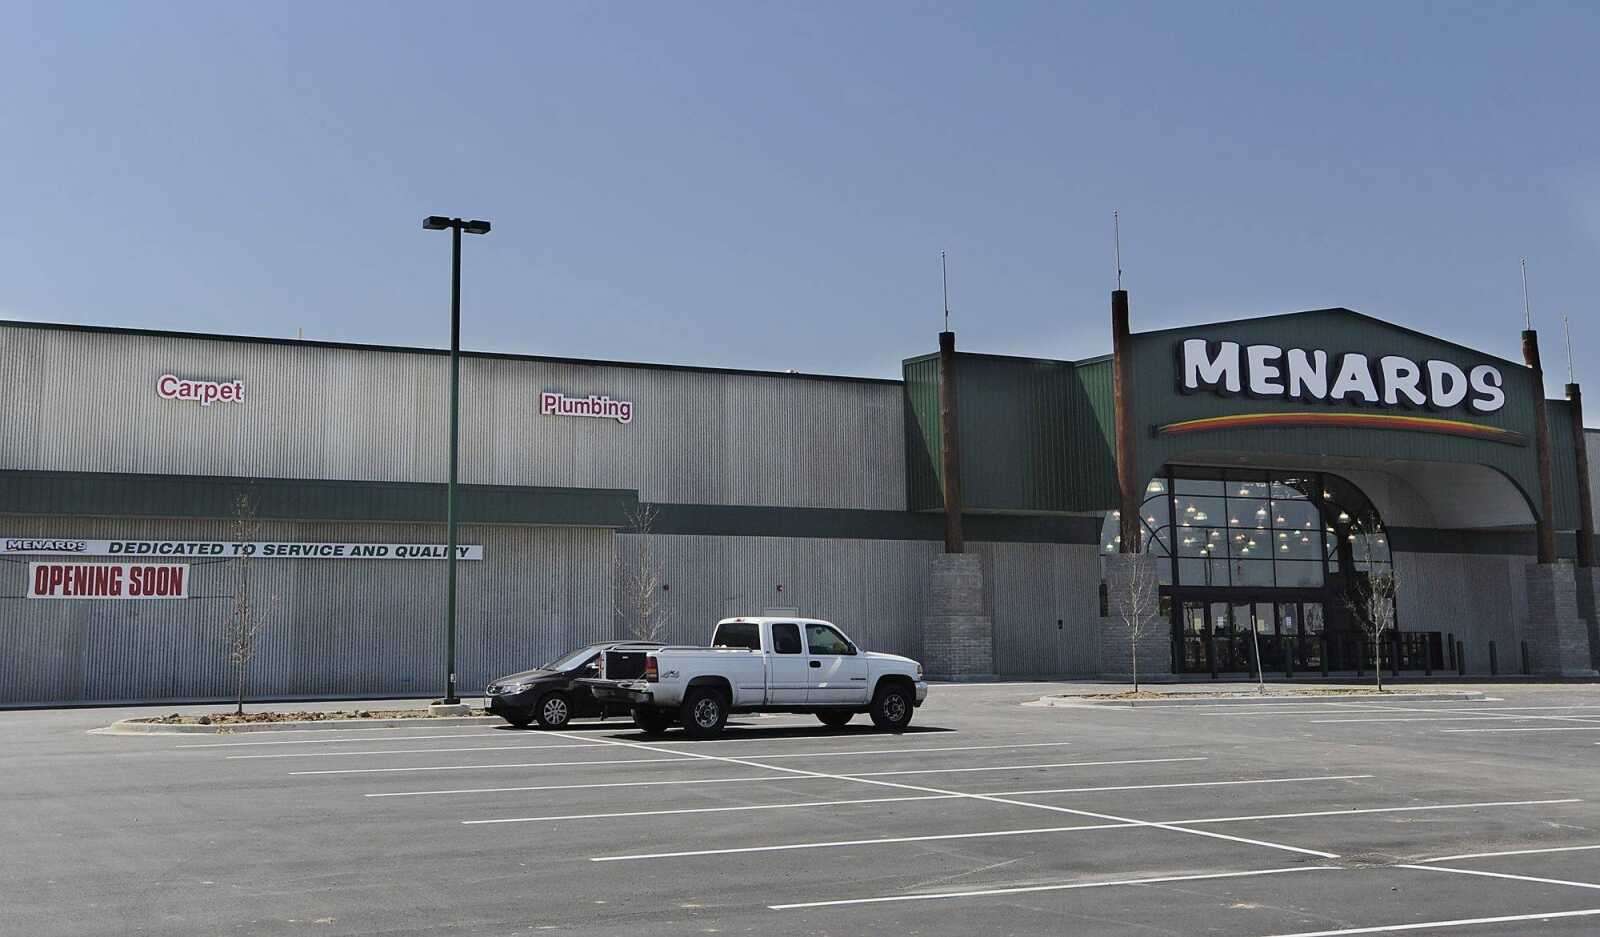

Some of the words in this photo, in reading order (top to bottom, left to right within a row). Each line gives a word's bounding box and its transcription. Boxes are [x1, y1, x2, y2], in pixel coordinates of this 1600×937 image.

[1182, 338, 1506, 412] MENARDS
[159, 376, 242, 403] Carpet
[543, 394, 631, 421] Plumbing
[6, 539, 88, 552] MENARDS
[108, 541, 224, 555] DEDICATED
[231, 543, 257, 556] TO
[262, 543, 345, 556] SERVICE
[350, 545, 389, 557] AND
[395, 545, 470, 558] QUALIY
[34, 565, 122, 596] OPENING
[128, 566, 183, 596] SOON
